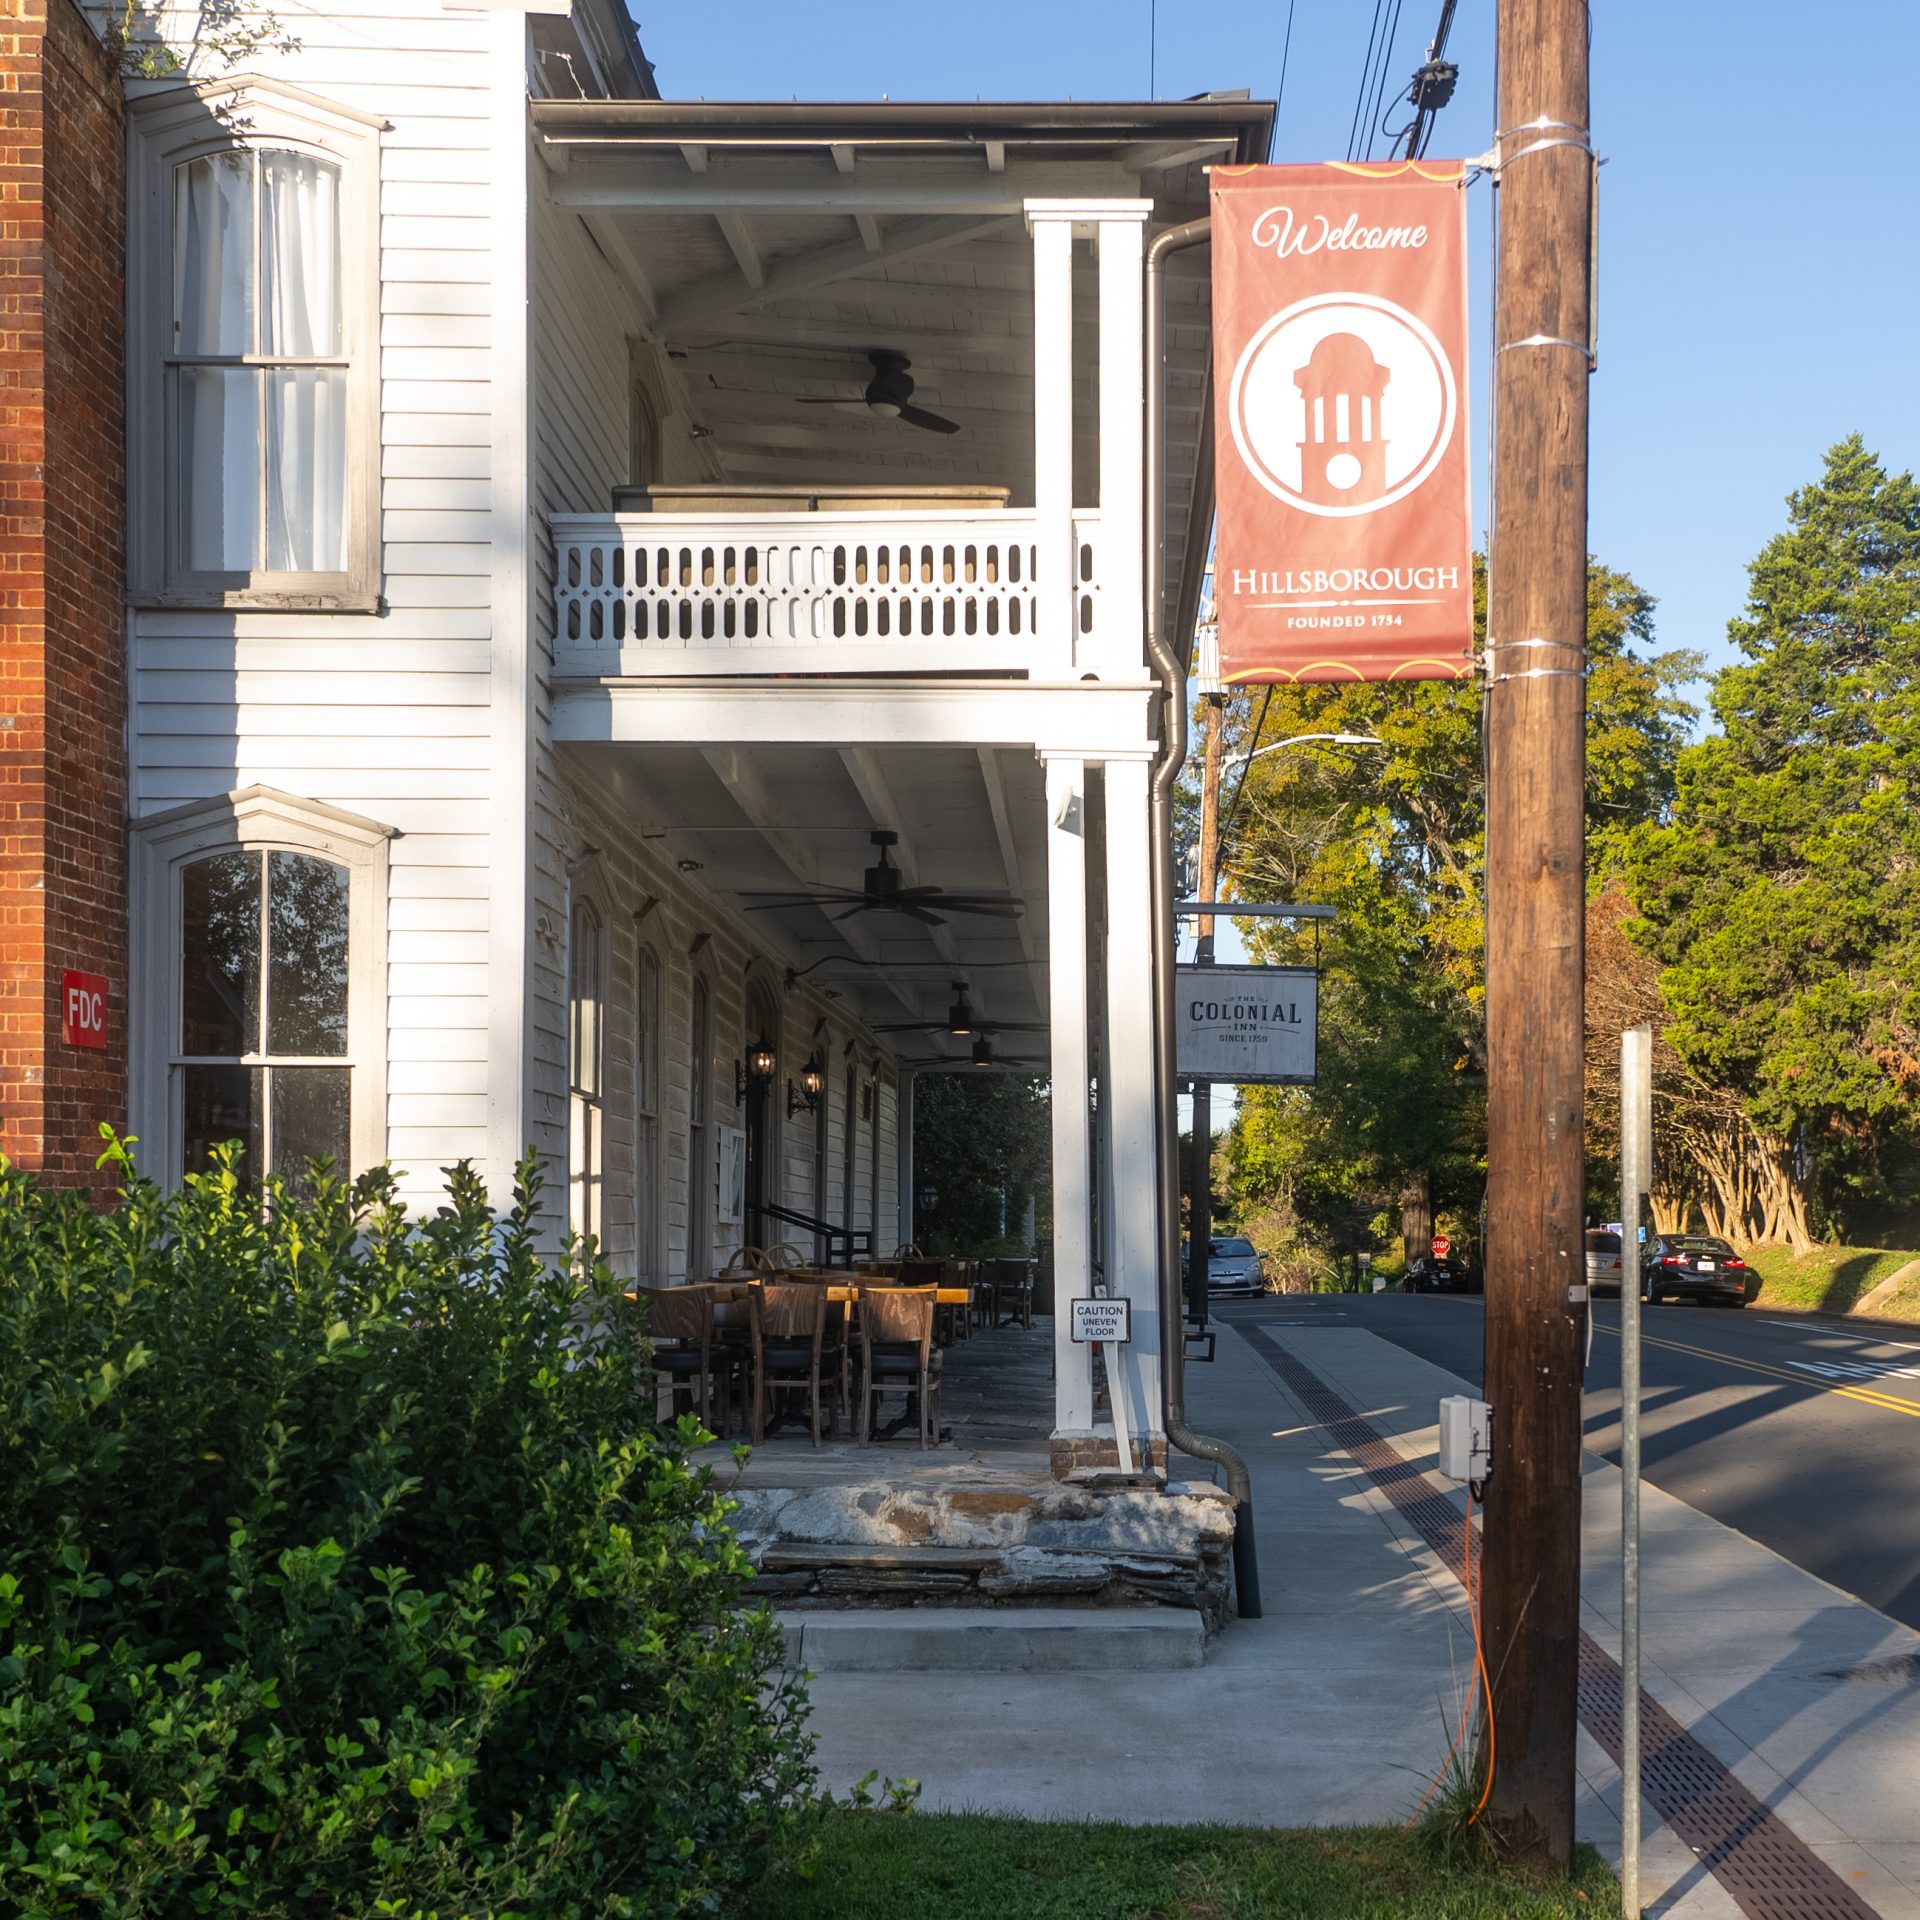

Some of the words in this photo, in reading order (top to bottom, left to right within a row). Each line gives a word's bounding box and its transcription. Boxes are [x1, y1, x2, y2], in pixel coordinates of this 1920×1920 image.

[1252, 206, 1428, 258] Welcome
[1232, 566, 1459, 595] HILLSBOROUGH
[1287, 615, 1366, 629] FOUNDED
[1371, 614, 1403, 627] 1754
[68, 988, 102, 1032] FDC
[1190, 1001, 1302, 1024] COLONIAL
[1233, 1023, 1257, 1031] INN
[1218, 1034, 1246, 1043] SINCE
[1248, 1034, 1268, 1043] 1759
[1432, 1240, 1449, 1249] STOP
[1077, 1306, 1123, 1316] CAUTION
[1082, 1318, 1117, 1326] UNEVEN
[1085, 1328, 1115, 1336] FLOOR
